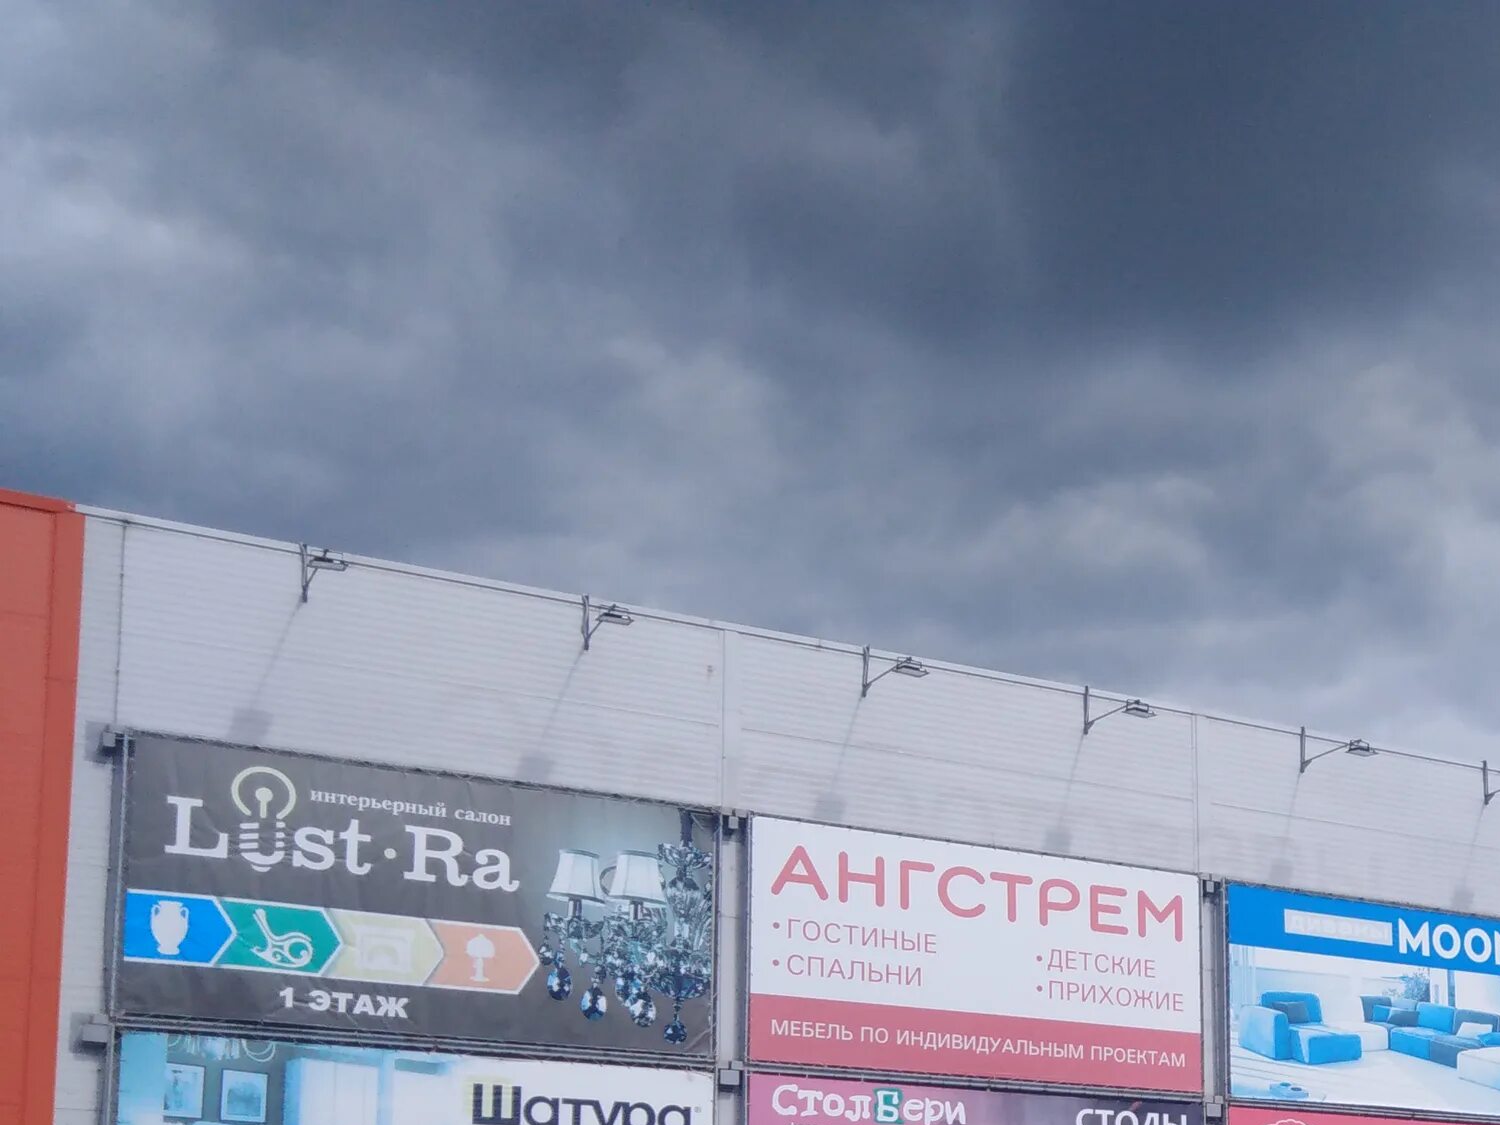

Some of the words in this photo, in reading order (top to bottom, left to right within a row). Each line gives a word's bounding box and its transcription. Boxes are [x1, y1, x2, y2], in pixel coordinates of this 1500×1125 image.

[310, 788, 447, 819] интерьерный
[455, 807, 512, 827] салон
[771, 844, 1184, 942] АНГСТРЕМ
[786, 917, 938, 954] ГОСТИНЫЕ
[786, 954, 922, 987] СПАЛЬНИ
[1047, 948, 1156, 979] ДЕТСКИЕ
[280, 987, 295, 1008] 1
[308, 989, 412, 1019] ЭТАЖ
[1048, 980, 1184, 1012] ПРИХОЖИЕ
[770, 1019, 854, 1042] МЕБЕЛЬ
[860, 1026, 889, 1044] ПО
[896, 1028, 1084, 1060] ИНДИВИДУАЛЬНЫМ
[1090, 1045, 1186, 1068] ПРОЕКТАМ
